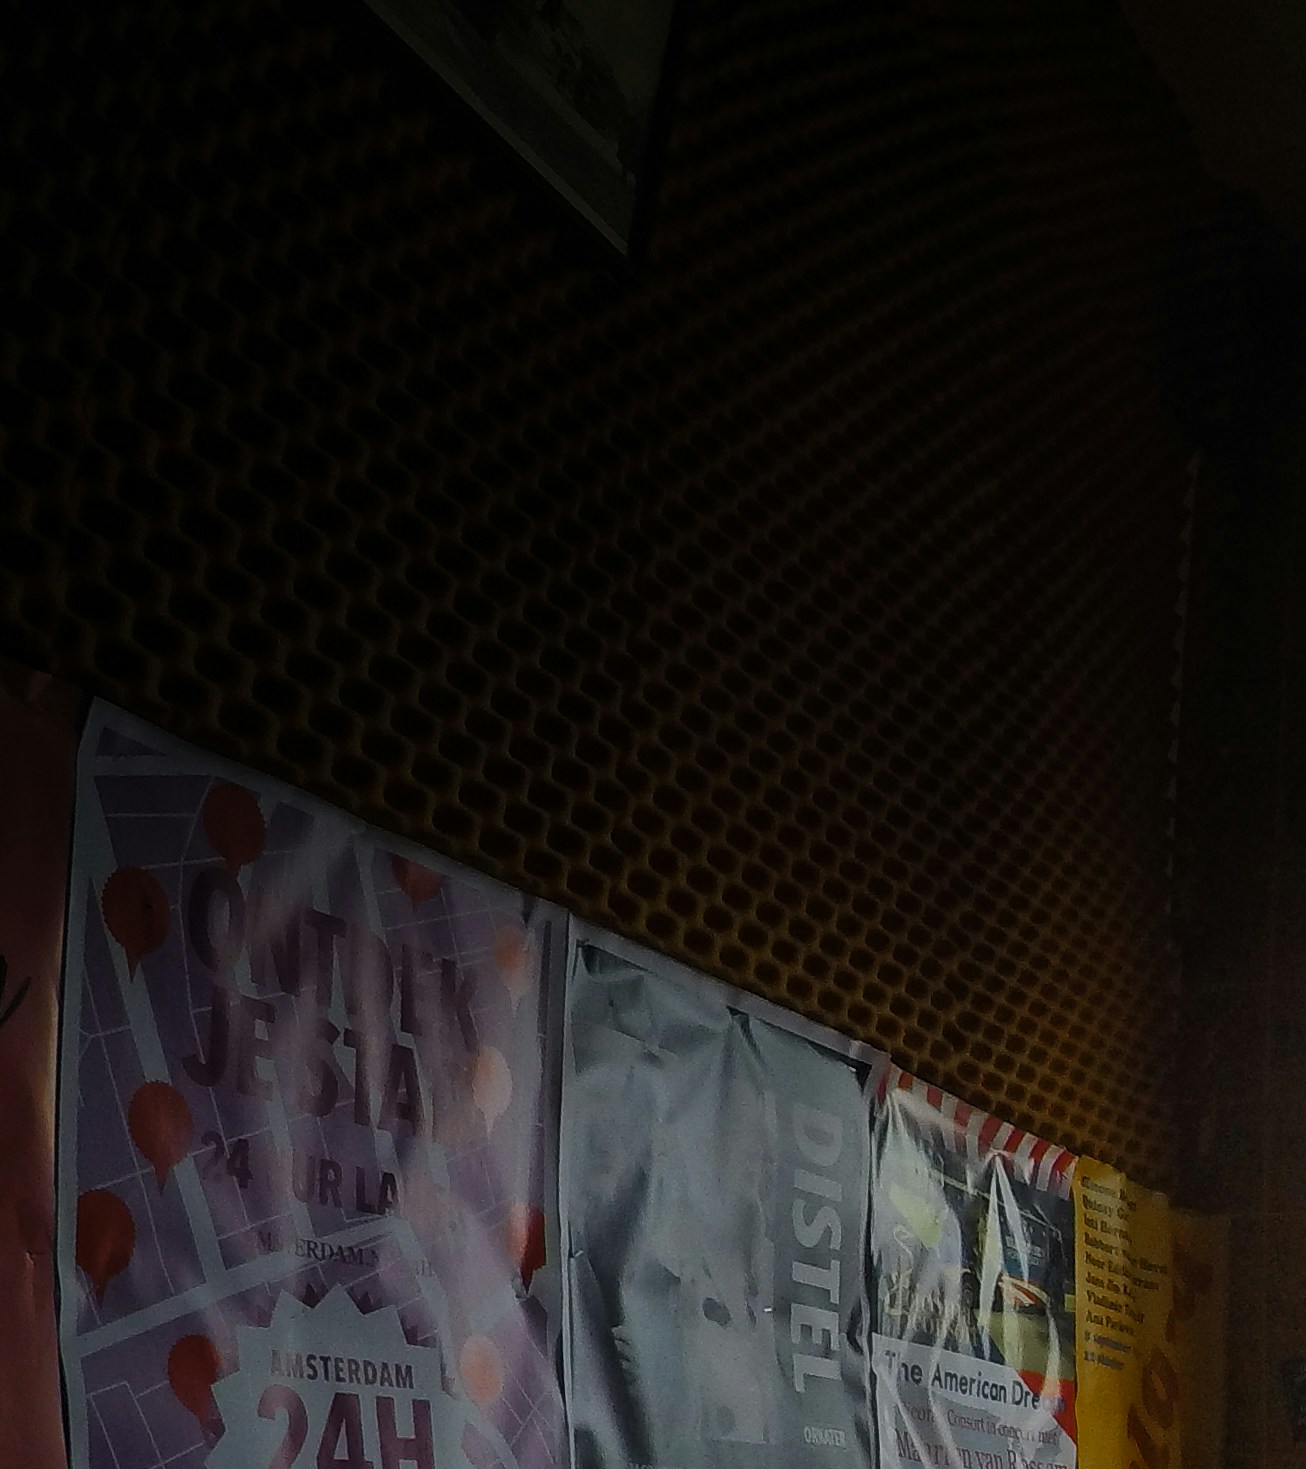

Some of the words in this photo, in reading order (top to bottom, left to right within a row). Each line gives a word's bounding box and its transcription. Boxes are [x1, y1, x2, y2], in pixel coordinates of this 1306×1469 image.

[792, 1102, 846, 1393] DISTEL
[270, 1350, 416, 1391] AMSTERDAM
[931, 1363, 1008, 1404] American
[895, 1429, 973, 1469] Maartn
